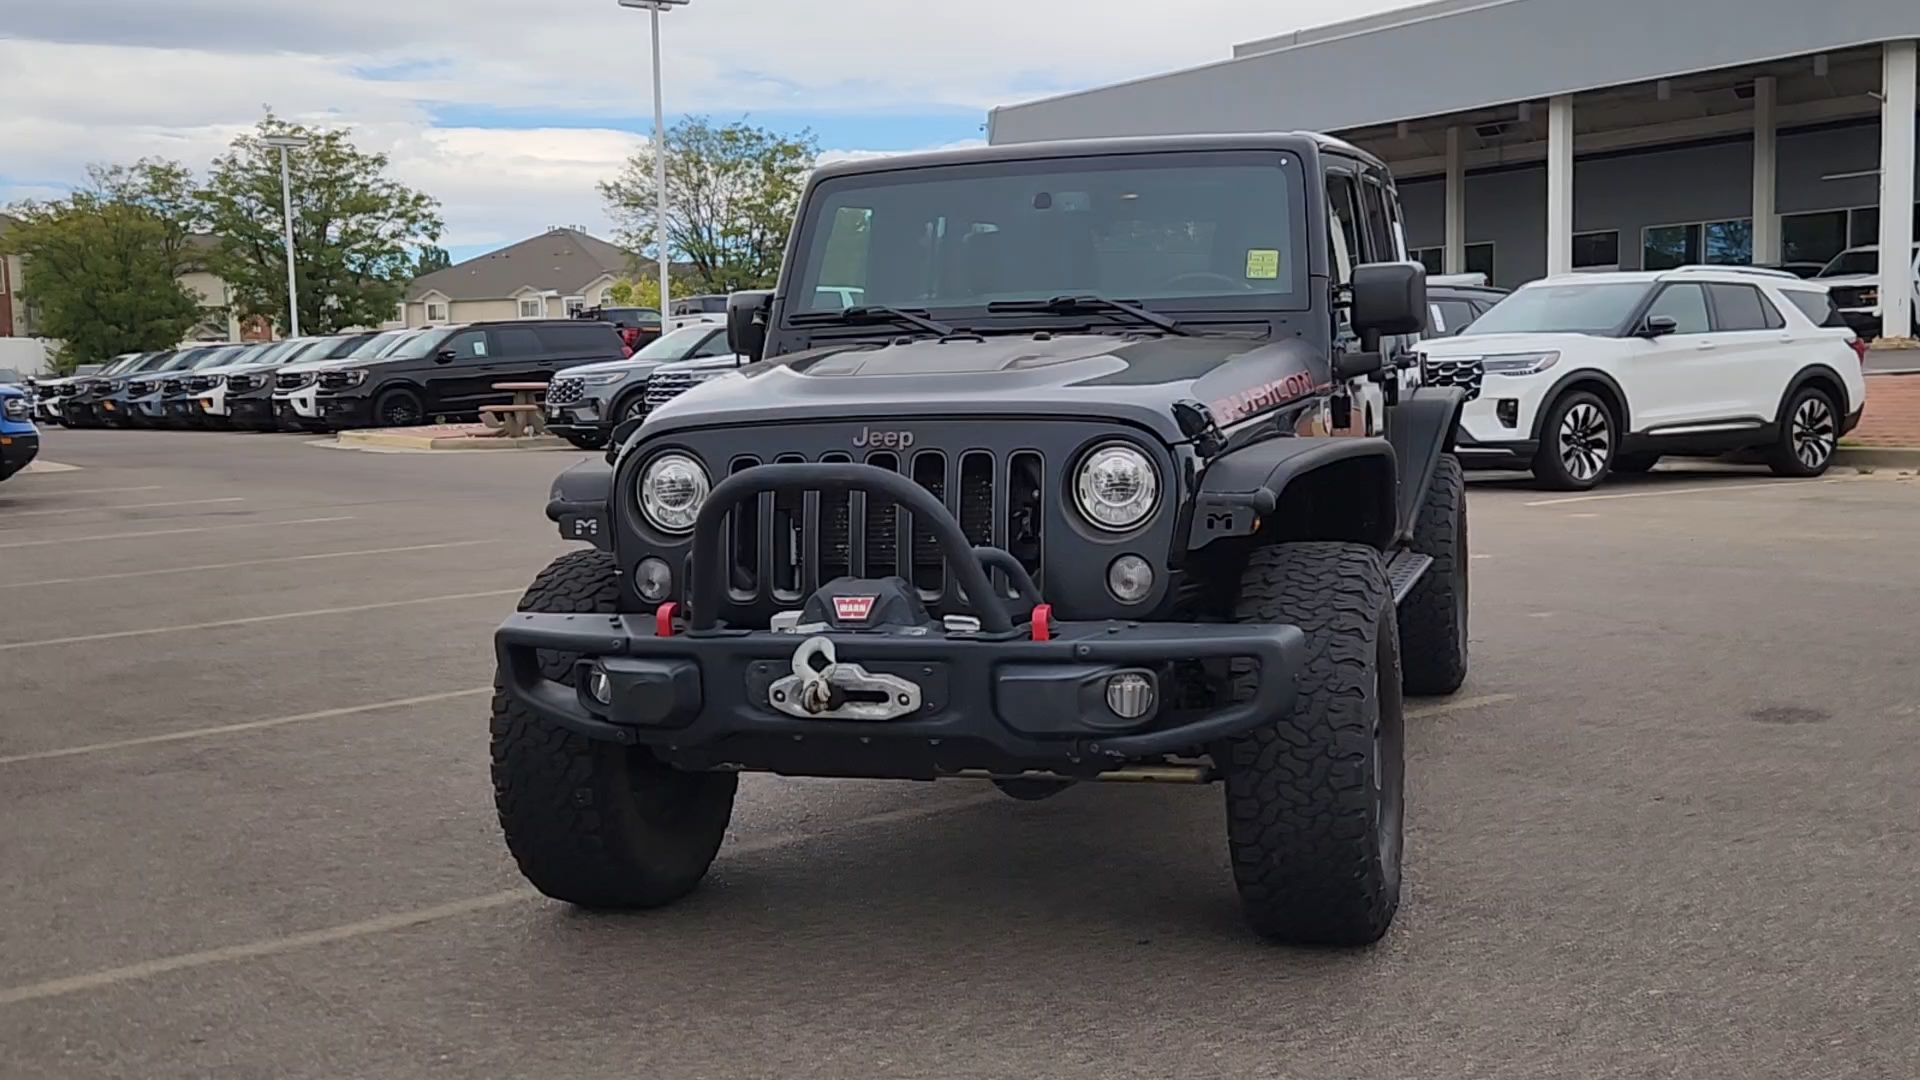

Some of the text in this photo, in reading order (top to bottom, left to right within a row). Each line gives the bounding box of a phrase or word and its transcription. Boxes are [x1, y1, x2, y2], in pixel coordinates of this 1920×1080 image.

[1211, 369, 1315, 426] RUBICON
[852, 426, 914, 450] Jeep
[840, 603, 866, 613] WARN
